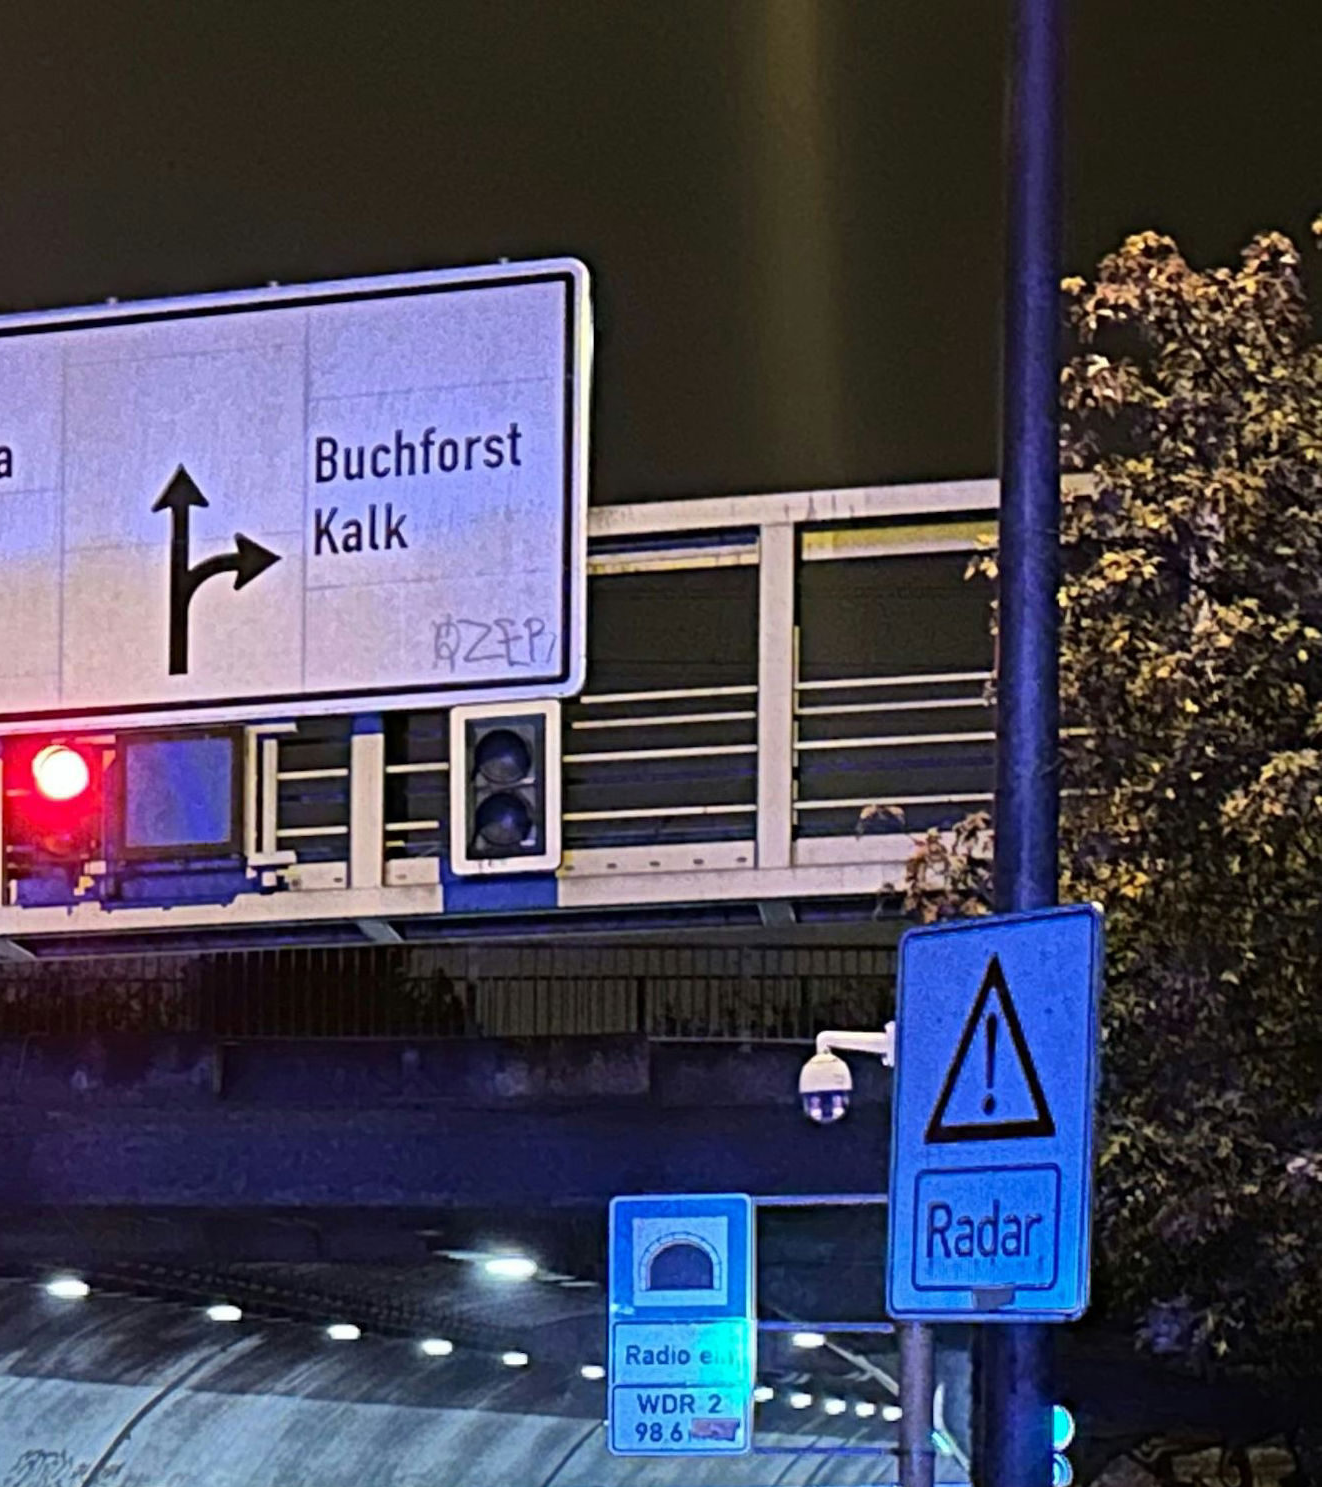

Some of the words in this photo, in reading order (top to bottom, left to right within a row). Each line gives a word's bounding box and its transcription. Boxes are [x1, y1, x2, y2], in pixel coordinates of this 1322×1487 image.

[315, 422, 523, 484] Buchforst
[314, 502, 409, 556] Kalk
[926, 1199, 1043, 1259] Radar
[625, 1344, 691, 1366] Radio
[637, 1393, 696, 1415] WDR
[708, 1393, 724, 1414] 2
